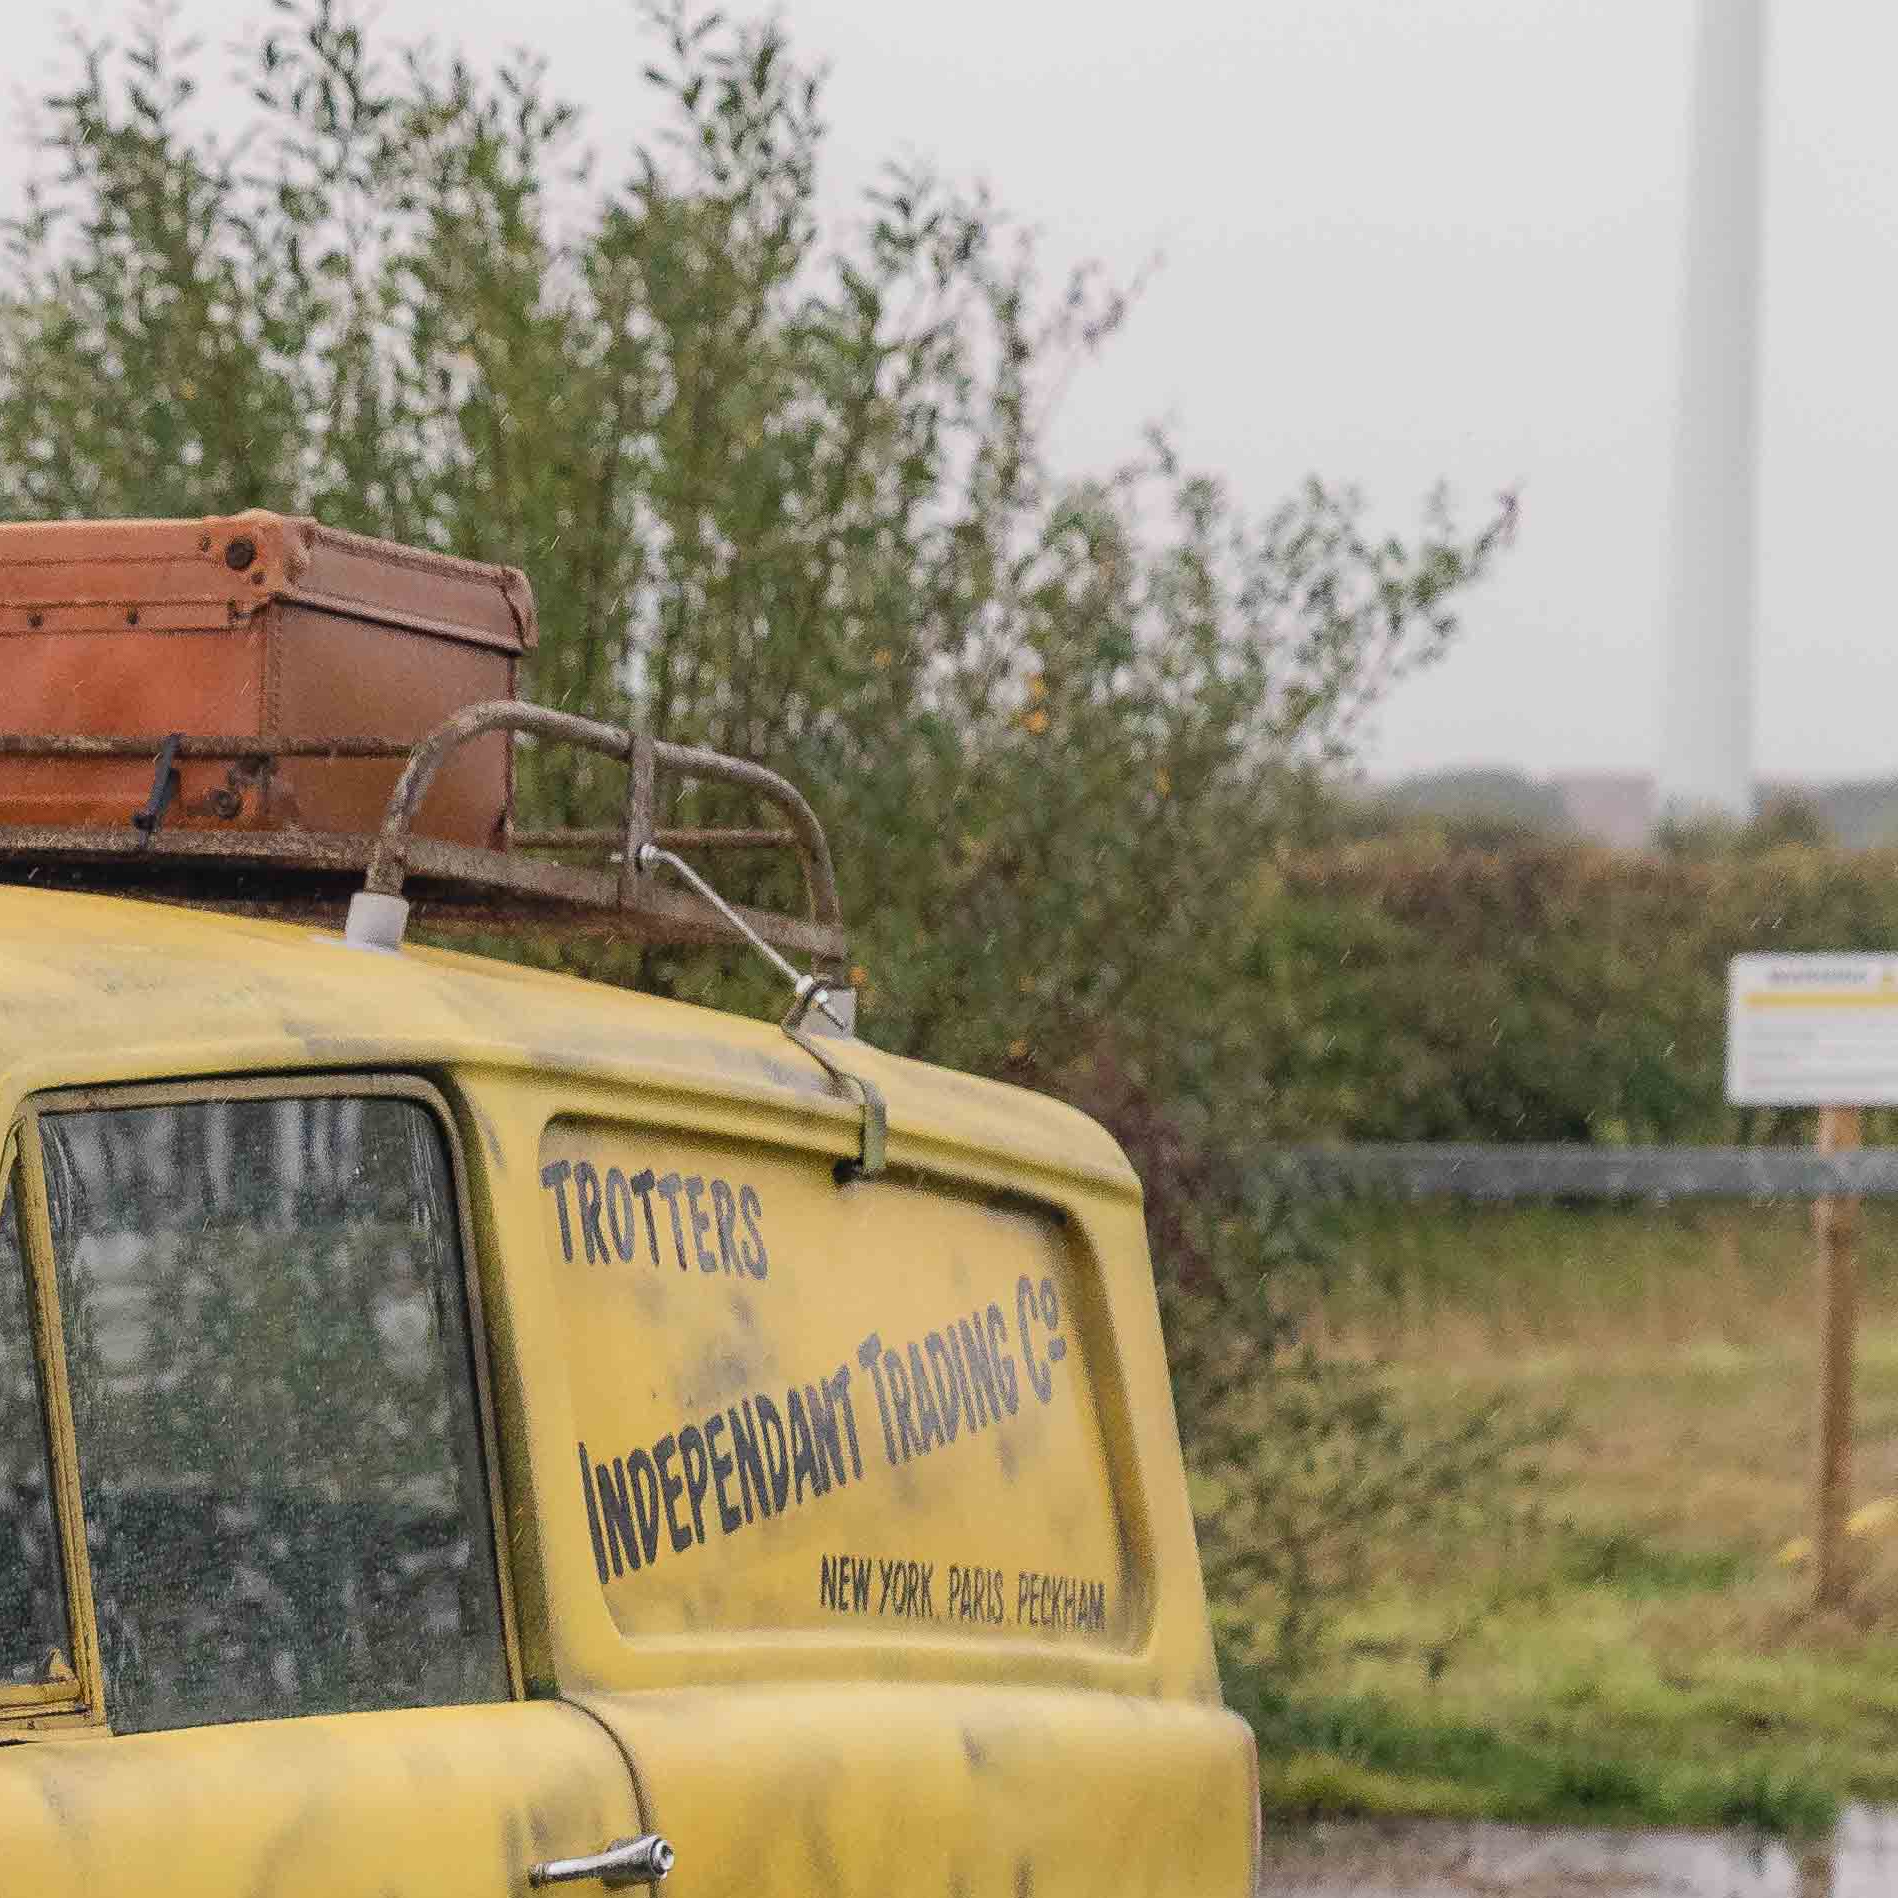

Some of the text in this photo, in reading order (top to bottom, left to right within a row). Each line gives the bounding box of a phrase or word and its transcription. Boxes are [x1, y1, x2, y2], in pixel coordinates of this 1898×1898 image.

[541, 1159, 769, 1281] TROTTERS
[578, 1363, 863, 1585] INDEPENDANT
[858, 1302, 1021, 1466] TRADING
[820, 1552, 872, 1616] NEW
[1017, 1570, 1107, 1633] PECKHAM
